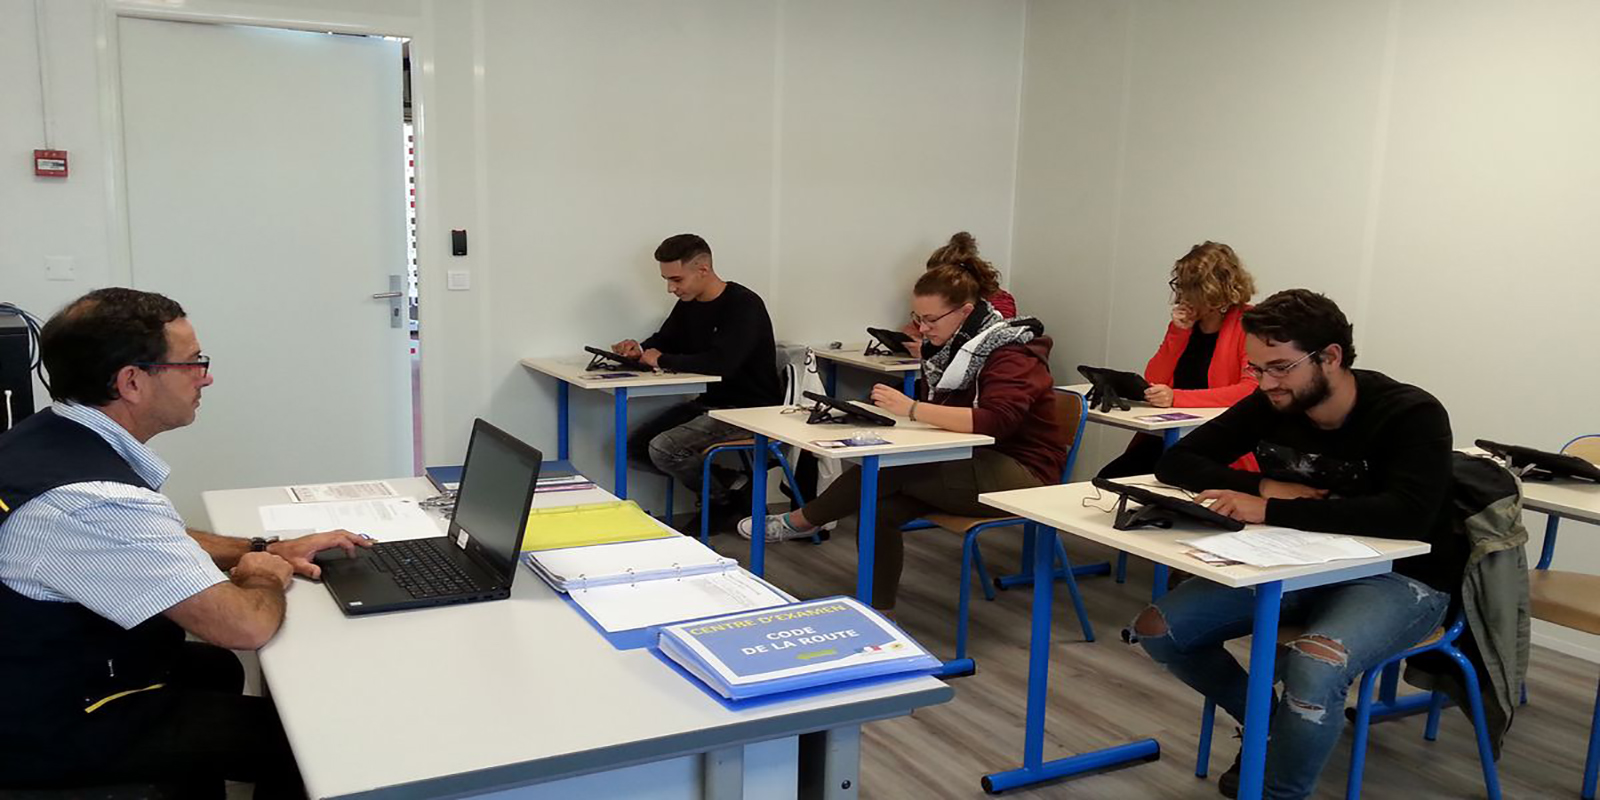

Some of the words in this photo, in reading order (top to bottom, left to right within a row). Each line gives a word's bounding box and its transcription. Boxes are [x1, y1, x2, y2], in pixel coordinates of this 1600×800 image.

[690, 618, 755, 636] CENTRE
[759, 604, 846, 625] D'EXAMEN
[766, 626, 817, 640] CODE
[742, 644, 769, 656] DE
[771, 639, 797, 651] LA
[799, 629, 860, 646] ROUTE
